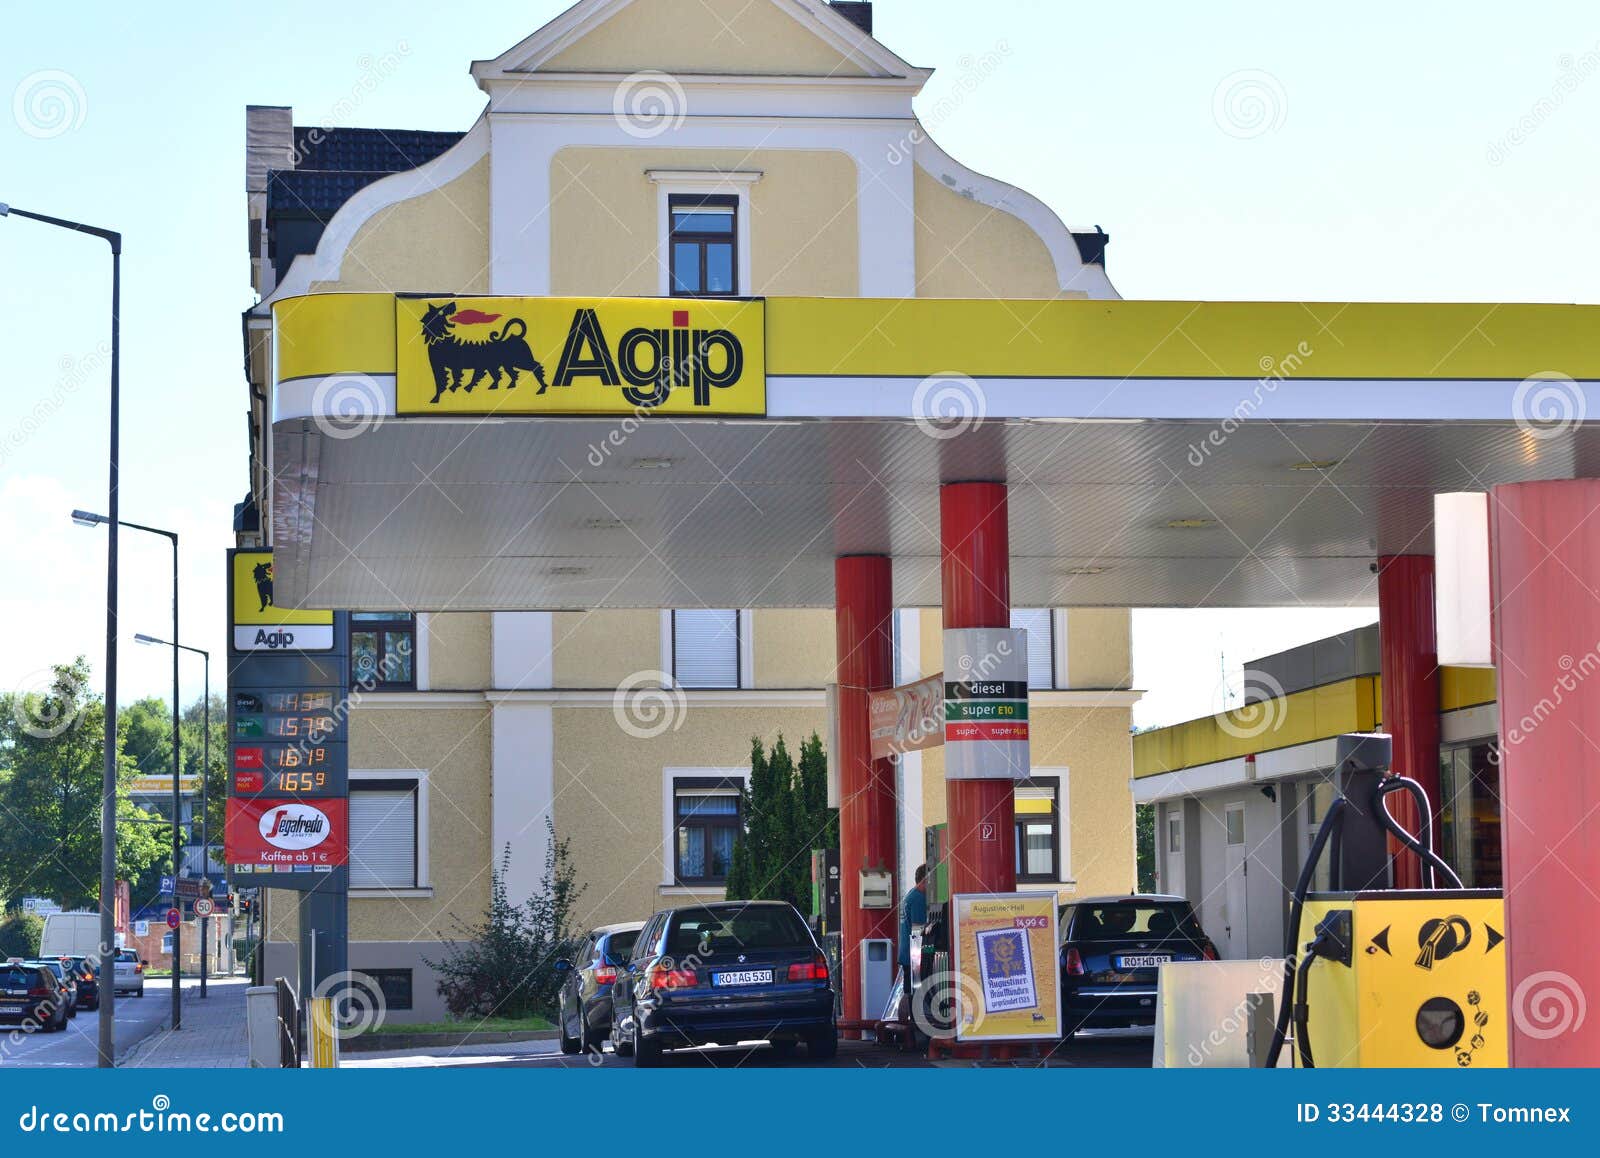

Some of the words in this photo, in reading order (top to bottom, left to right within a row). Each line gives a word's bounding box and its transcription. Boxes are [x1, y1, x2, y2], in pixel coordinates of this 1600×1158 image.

[551, 309, 743, 407] Agip
[255, 629, 294, 648] Agip
[971, 682, 1005, 694] diesel
[962, 705, 995, 717] super
[997, 706, 1014, 715] E10
[956, 728, 978, 736] super
[991, 727, 1012, 735] super
[237, 754, 254, 763] super
[237, 775, 254, 784] super
[265, 810, 324, 838] Segafredo
[261, 851, 292, 861] Kaffee
[296, 851, 308, 861] ab
[311, 852, 316, 861] 1
[320, 853, 328, 862] €
[199, 902, 211, 912] 50
[973, 904, 1009, 913] Augustiner
[719, 973, 732, 984] RO
[739, 972, 751, 983] AG
